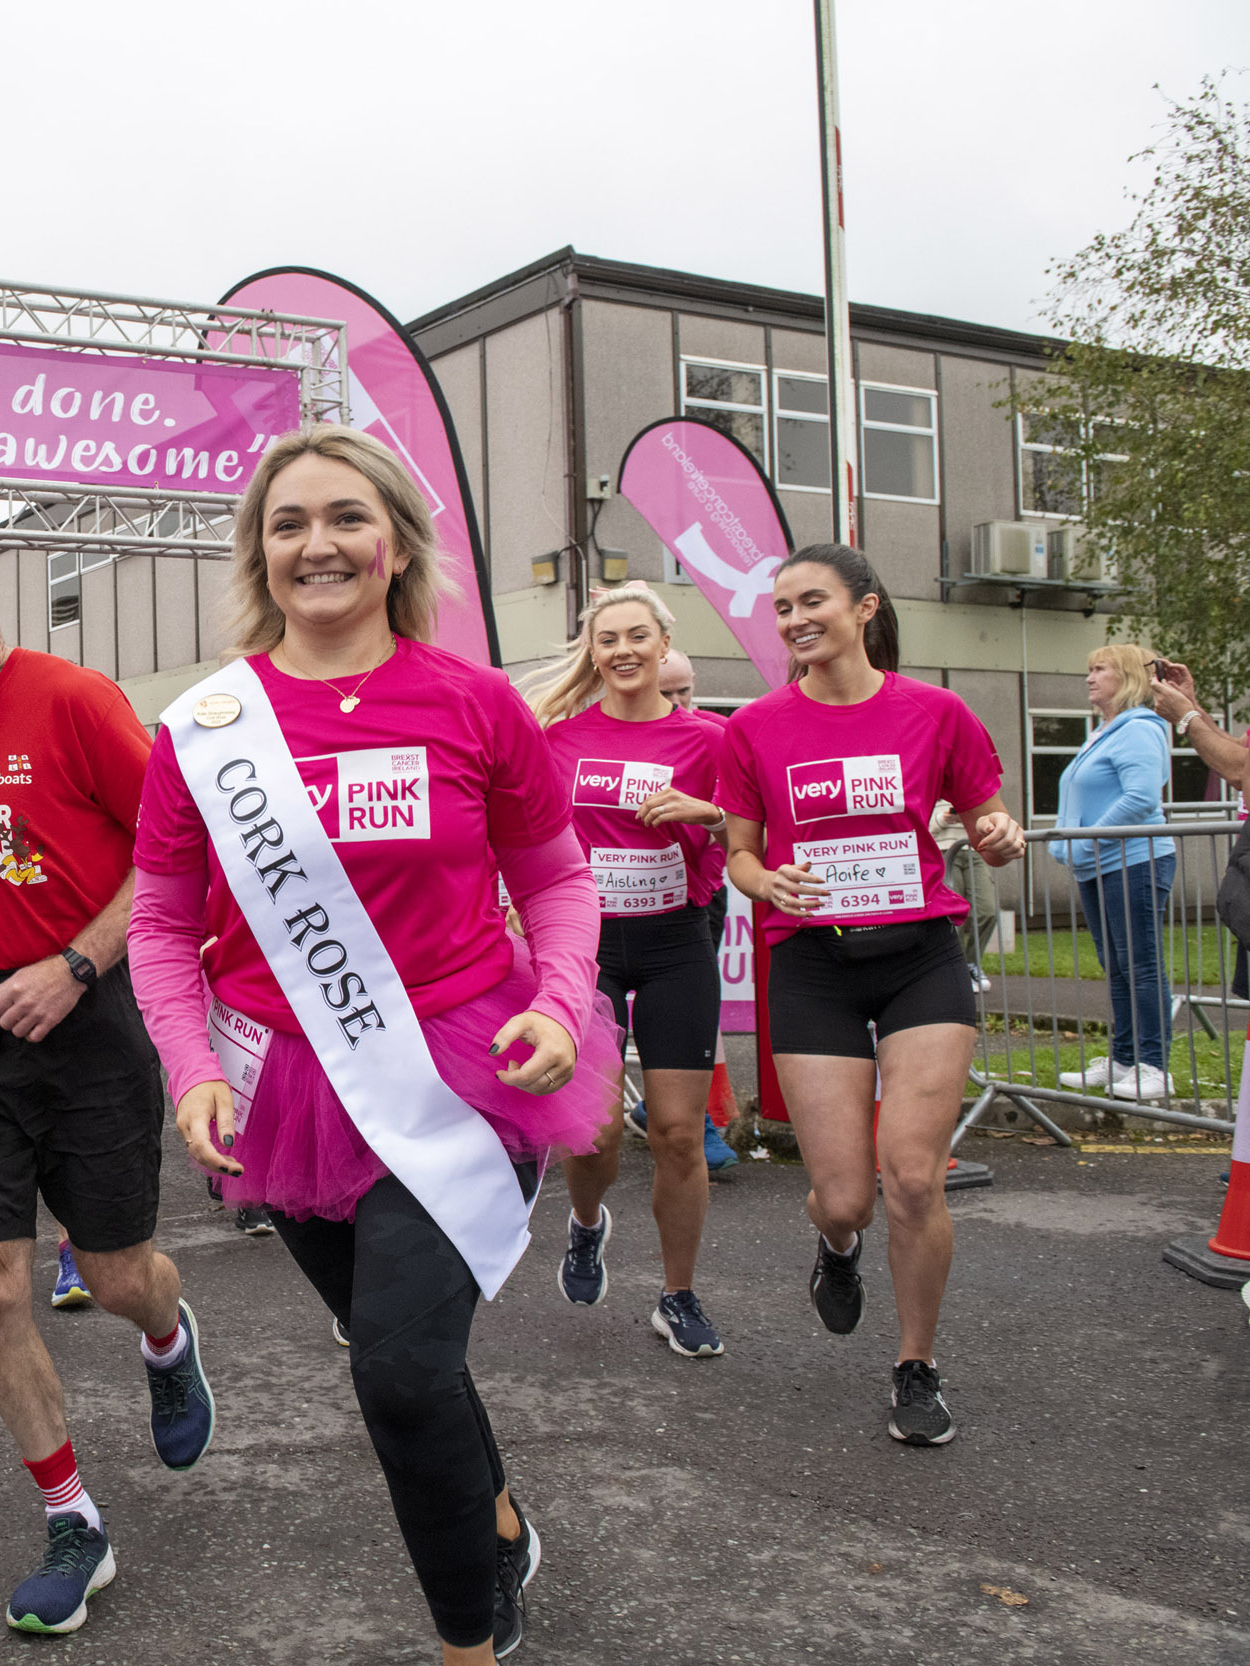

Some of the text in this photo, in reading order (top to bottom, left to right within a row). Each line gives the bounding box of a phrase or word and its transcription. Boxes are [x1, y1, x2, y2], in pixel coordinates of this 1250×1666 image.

[11, 373, 176, 428] done.
[348, 778, 421, 803] PINK
[579, 774, 620, 792] very
[626, 778, 666, 792] PINK
[794, 779, 842, 799] very
[851, 776, 898, 793] PINK
[624, 791, 653, 805] RU
[852, 793, 895, 810] RUN
[349, 805, 414, 830] RUN
[598, 851, 680, 864] VERY PINK RUN
[803, 839, 909, 858] VERY PINK RUN
[605, 871, 656, 891] Aisling
[825, 863, 870, 883] Aoife
[215, 758, 309, 905] CORK
[283, 901, 387, 1051] ROSE
[623, 897, 656, 908] 6393
[841, 894, 880, 908] 6394
[213, 1001, 263, 1045] PINK RUN
